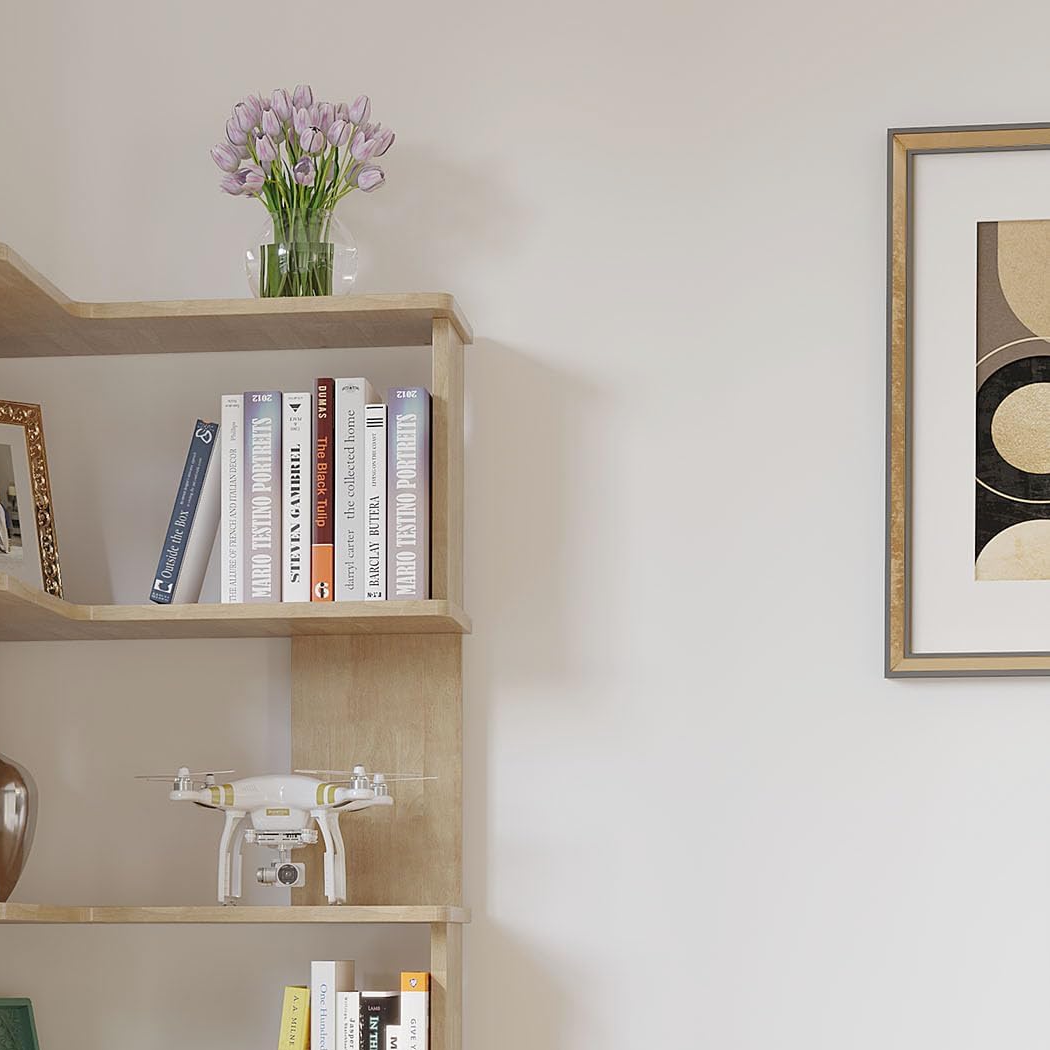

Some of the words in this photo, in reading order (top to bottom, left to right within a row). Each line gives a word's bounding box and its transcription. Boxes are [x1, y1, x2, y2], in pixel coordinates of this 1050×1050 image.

[252, 394, 272, 402] 2012
[318, 385, 327, 419] DUMAS
[396, 390, 417, 399] 2012
[344, 409, 355, 443] home
[229, 448, 237, 473] DECOR
[316, 436, 328, 458] The
[290, 444, 301, 518] GAMBREL
[316, 463, 328, 495] Black
[344, 446, 355, 497] collected
[229, 474, 237, 502] ITALIAN
[175, 509, 189, 527] Box
[229, 503, 237, 518] AND
[251, 496, 272, 550] TESTINO
[316, 499, 328, 527] Tulip
[344, 500, 355, 519] the
[368, 495, 380, 536] BUTERA
[396, 492, 417, 547] TESTINO
[171, 522, 184, 543] the
[229, 520, 237, 547] FRENCH
[346, 529, 355, 558] carter
[161, 544, 180, 578] Outside
[229, 548, 237, 558] OF
[290, 523, 301, 583] STEVEN
[368, 541, 380, 587] BARCLAY
[229, 560, 237, 585] ALLURE
[251, 554, 272, 598] MARIO
[344, 562, 357, 590] darryl
[396, 551, 417, 595] MARIO
[229, 588, 237, 601] THE
[319, 984, 328, 1005] One
[288, 1017, 297, 1047] MILNE
[348, 1018, 357, 1049] Jasper
[369, 1016, 379, 1029] IN
